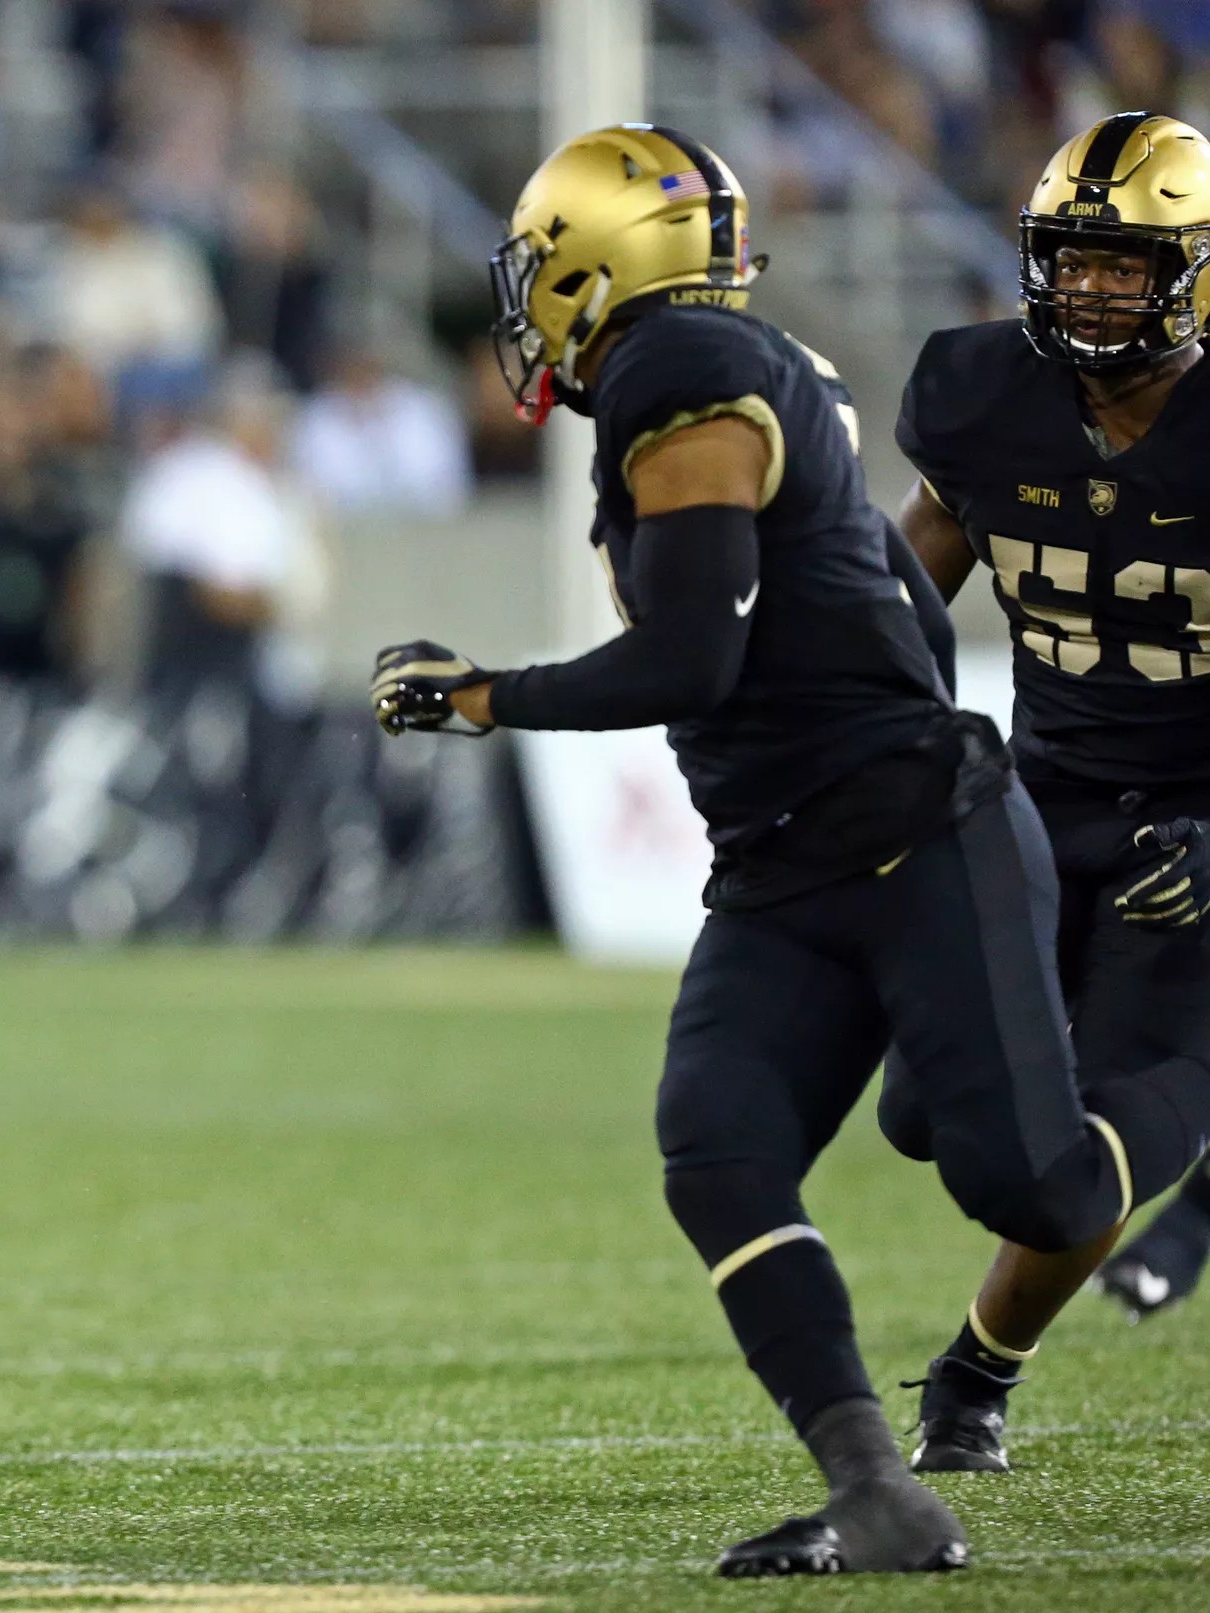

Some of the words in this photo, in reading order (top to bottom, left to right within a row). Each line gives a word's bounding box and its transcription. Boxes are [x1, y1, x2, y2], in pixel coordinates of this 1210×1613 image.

[1067, 203, 1103, 216] ARMY
[1018, 485, 1059, 507] SMITH
[989, 533, 1210, 682] 53
